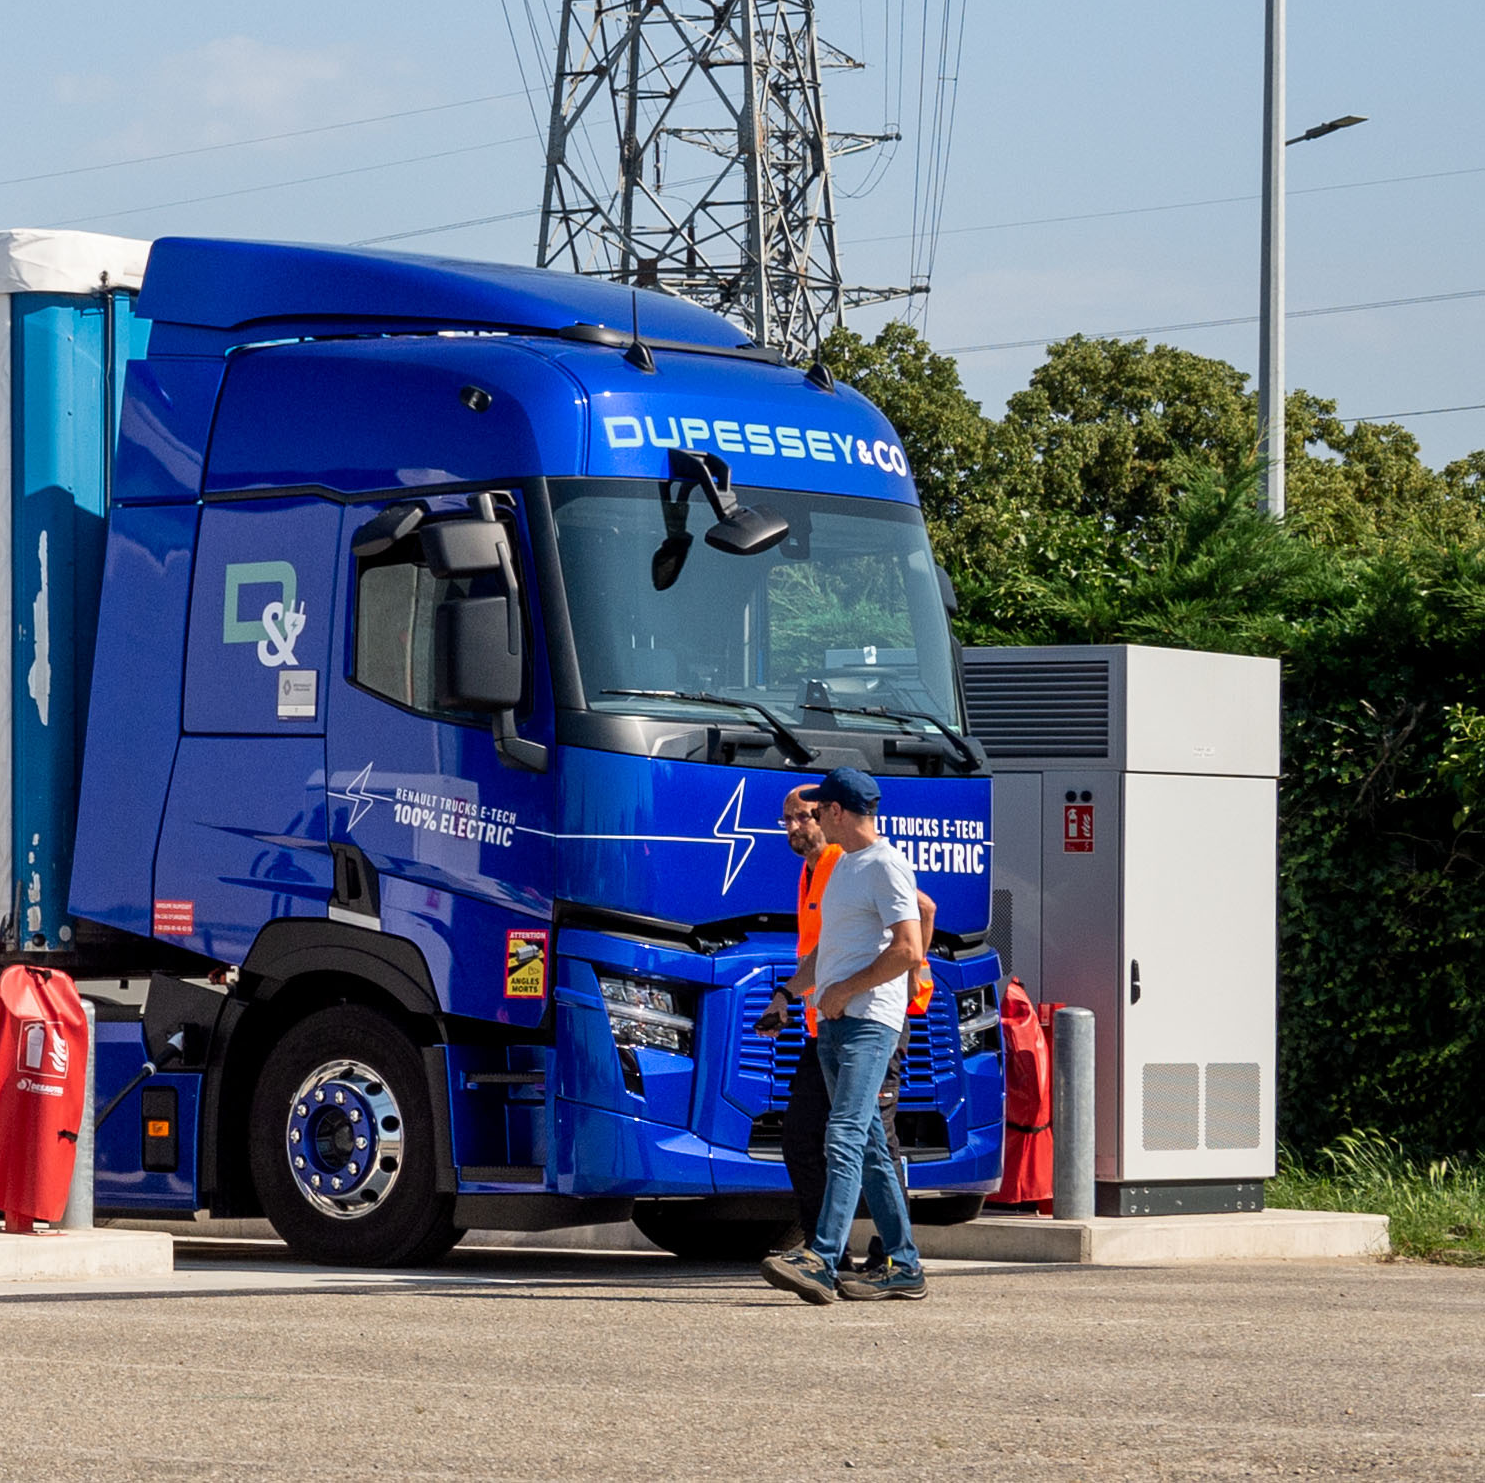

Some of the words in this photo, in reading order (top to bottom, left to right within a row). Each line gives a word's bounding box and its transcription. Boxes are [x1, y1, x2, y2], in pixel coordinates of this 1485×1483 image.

[603, 416, 907, 477] DUPESSEY&CO
[396, 787, 437, 807] RENAULT
[440, 797, 477, 817] TRUCKS
[480, 806, 517, 825] E-TECH
[394, 803, 437, 831] 100%
[439, 813, 513, 847] ELECTRIC
[891, 816, 939, 837] TRUCKS
[943, 819, 984, 839] E-TECH
[511, 977, 540, 986] ANGLES
[512, 985, 538, 993] MORTS
